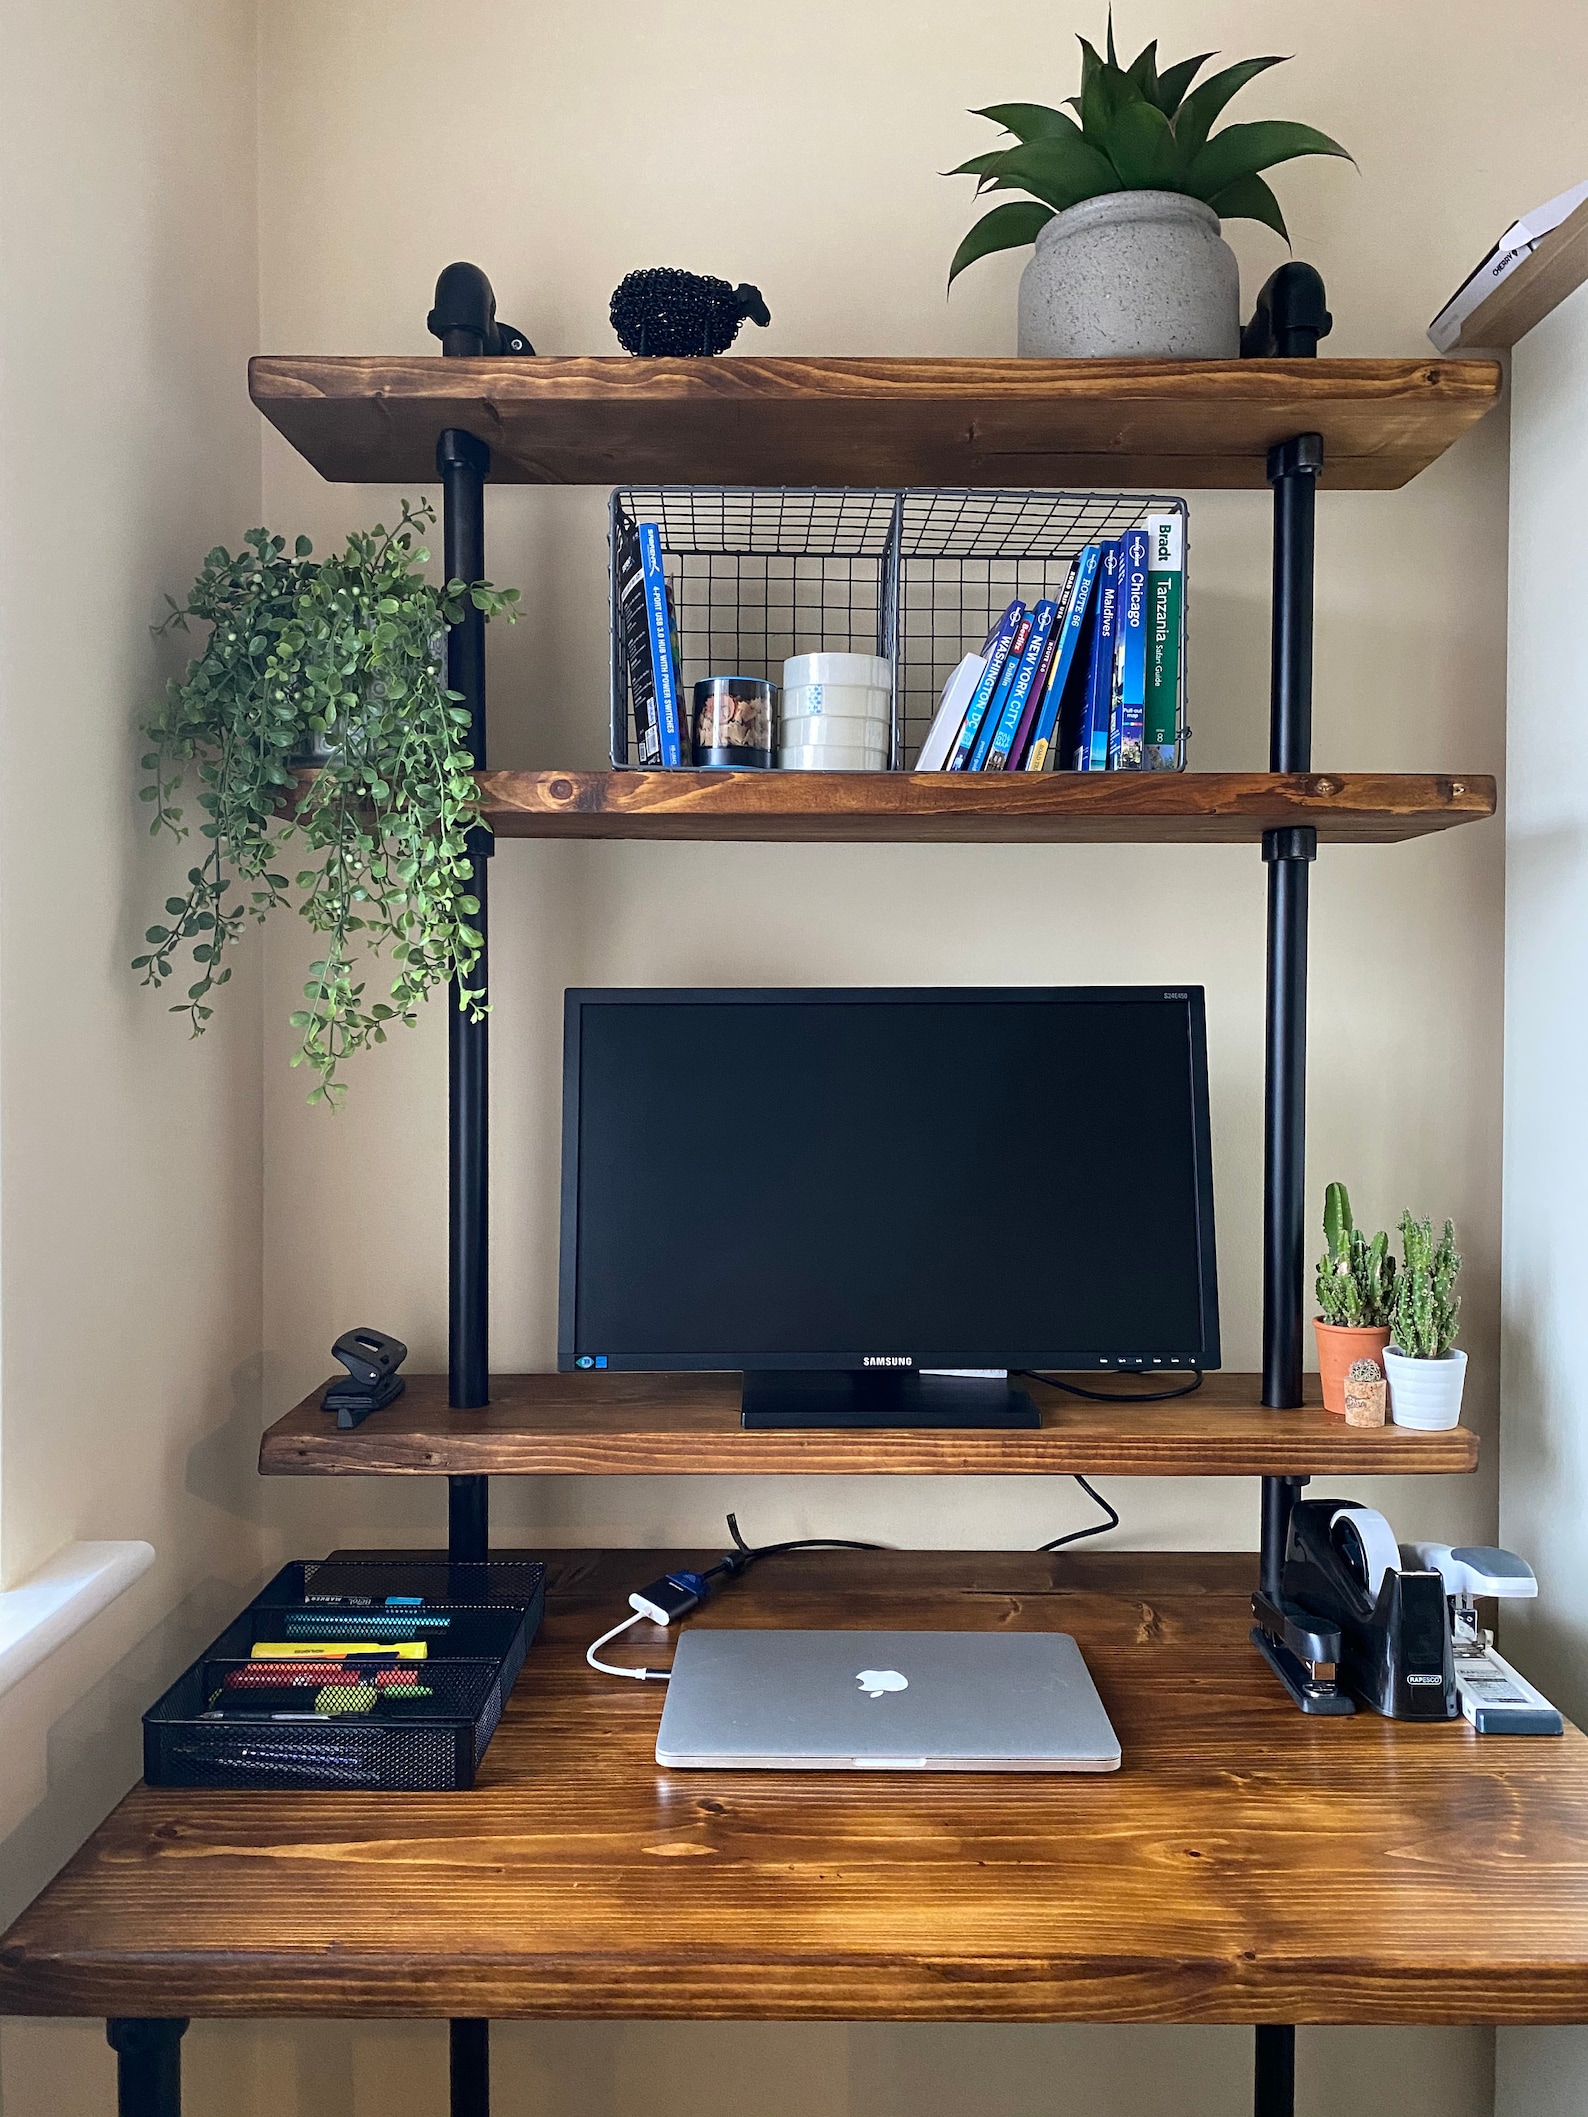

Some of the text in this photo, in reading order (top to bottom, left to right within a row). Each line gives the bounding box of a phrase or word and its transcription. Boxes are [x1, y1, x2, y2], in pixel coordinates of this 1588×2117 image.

[1492, 252, 1513, 277] CHERRY
[1158, 524, 1172, 562] Bradt
[1056, 571, 1076, 619] ROAD TRIP USA
[1071, 577, 1091, 627] ROUTE 66
[1101, 588, 1116, 637] Maldives
[1127, 572, 1145, 628] Chicago
[1014, 622, 1029, 651] Berlitz
[1154, 577, 1172, 687] Tanzania Safari Guide
[652, 585, 675, 734] 4-PORT USB 3.0 HUB WITH POWER SWITCHES
[1042, 641, 1054, 662] ROUTE
[974, 635, 1012, 711] WASHINGTON,
[1001, 662, 1016, 687] Dublin
[1004, 634, 1044, 730] NEW YORK CITY
[968, 712, 982, 729] DC
[1156, 732, 1164, 743] 8
[863, 1356, 913, 1367] SAMSUNG
[1409, 1675, 1440, 1684] RAPESCO
